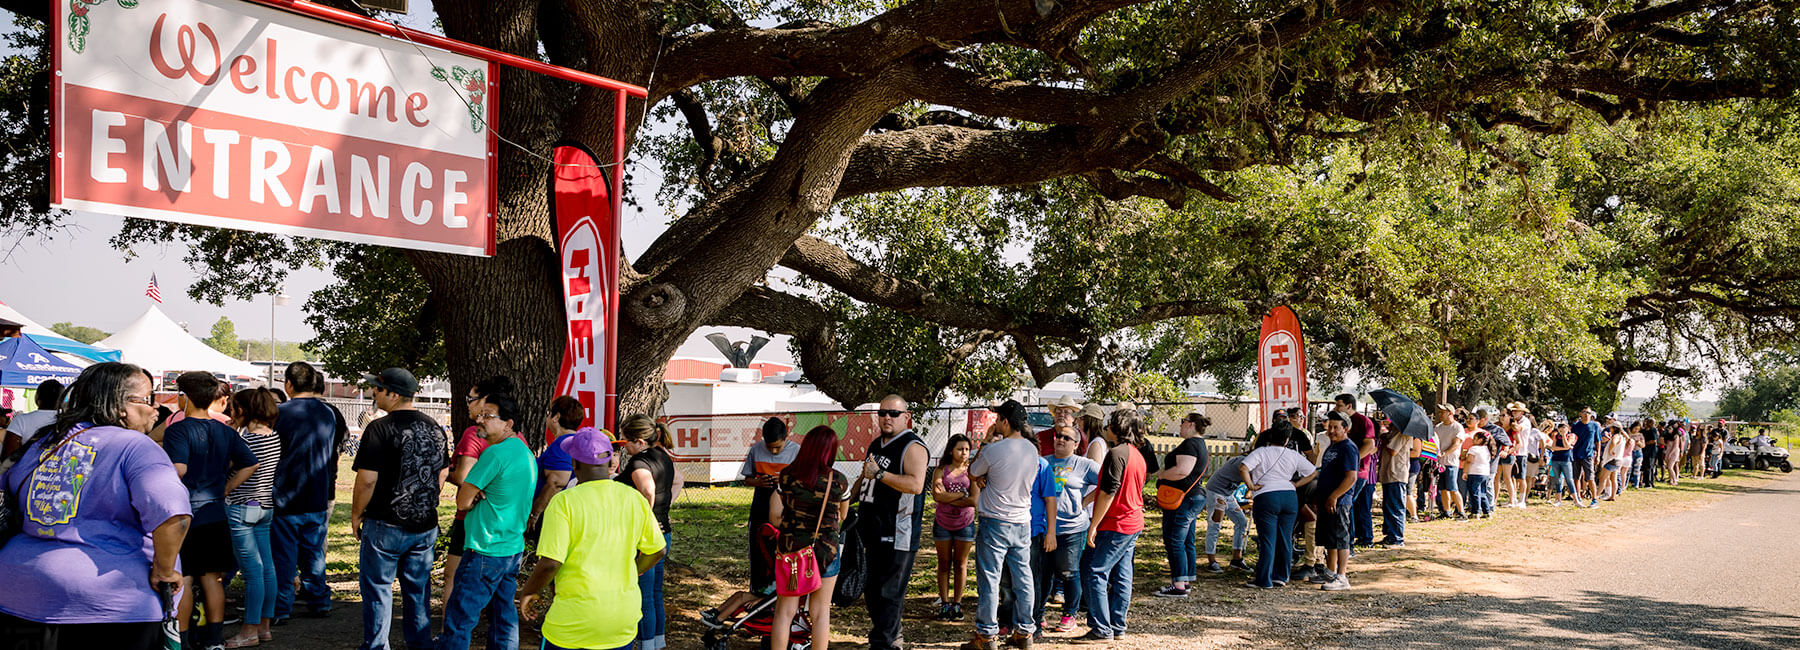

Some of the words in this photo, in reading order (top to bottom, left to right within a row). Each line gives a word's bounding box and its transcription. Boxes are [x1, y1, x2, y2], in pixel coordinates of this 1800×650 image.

[149, 13, 430, 127] Welcome
[91, 109, 469, 229] ENTRANCE
[860, 477, 876, 503] 21
